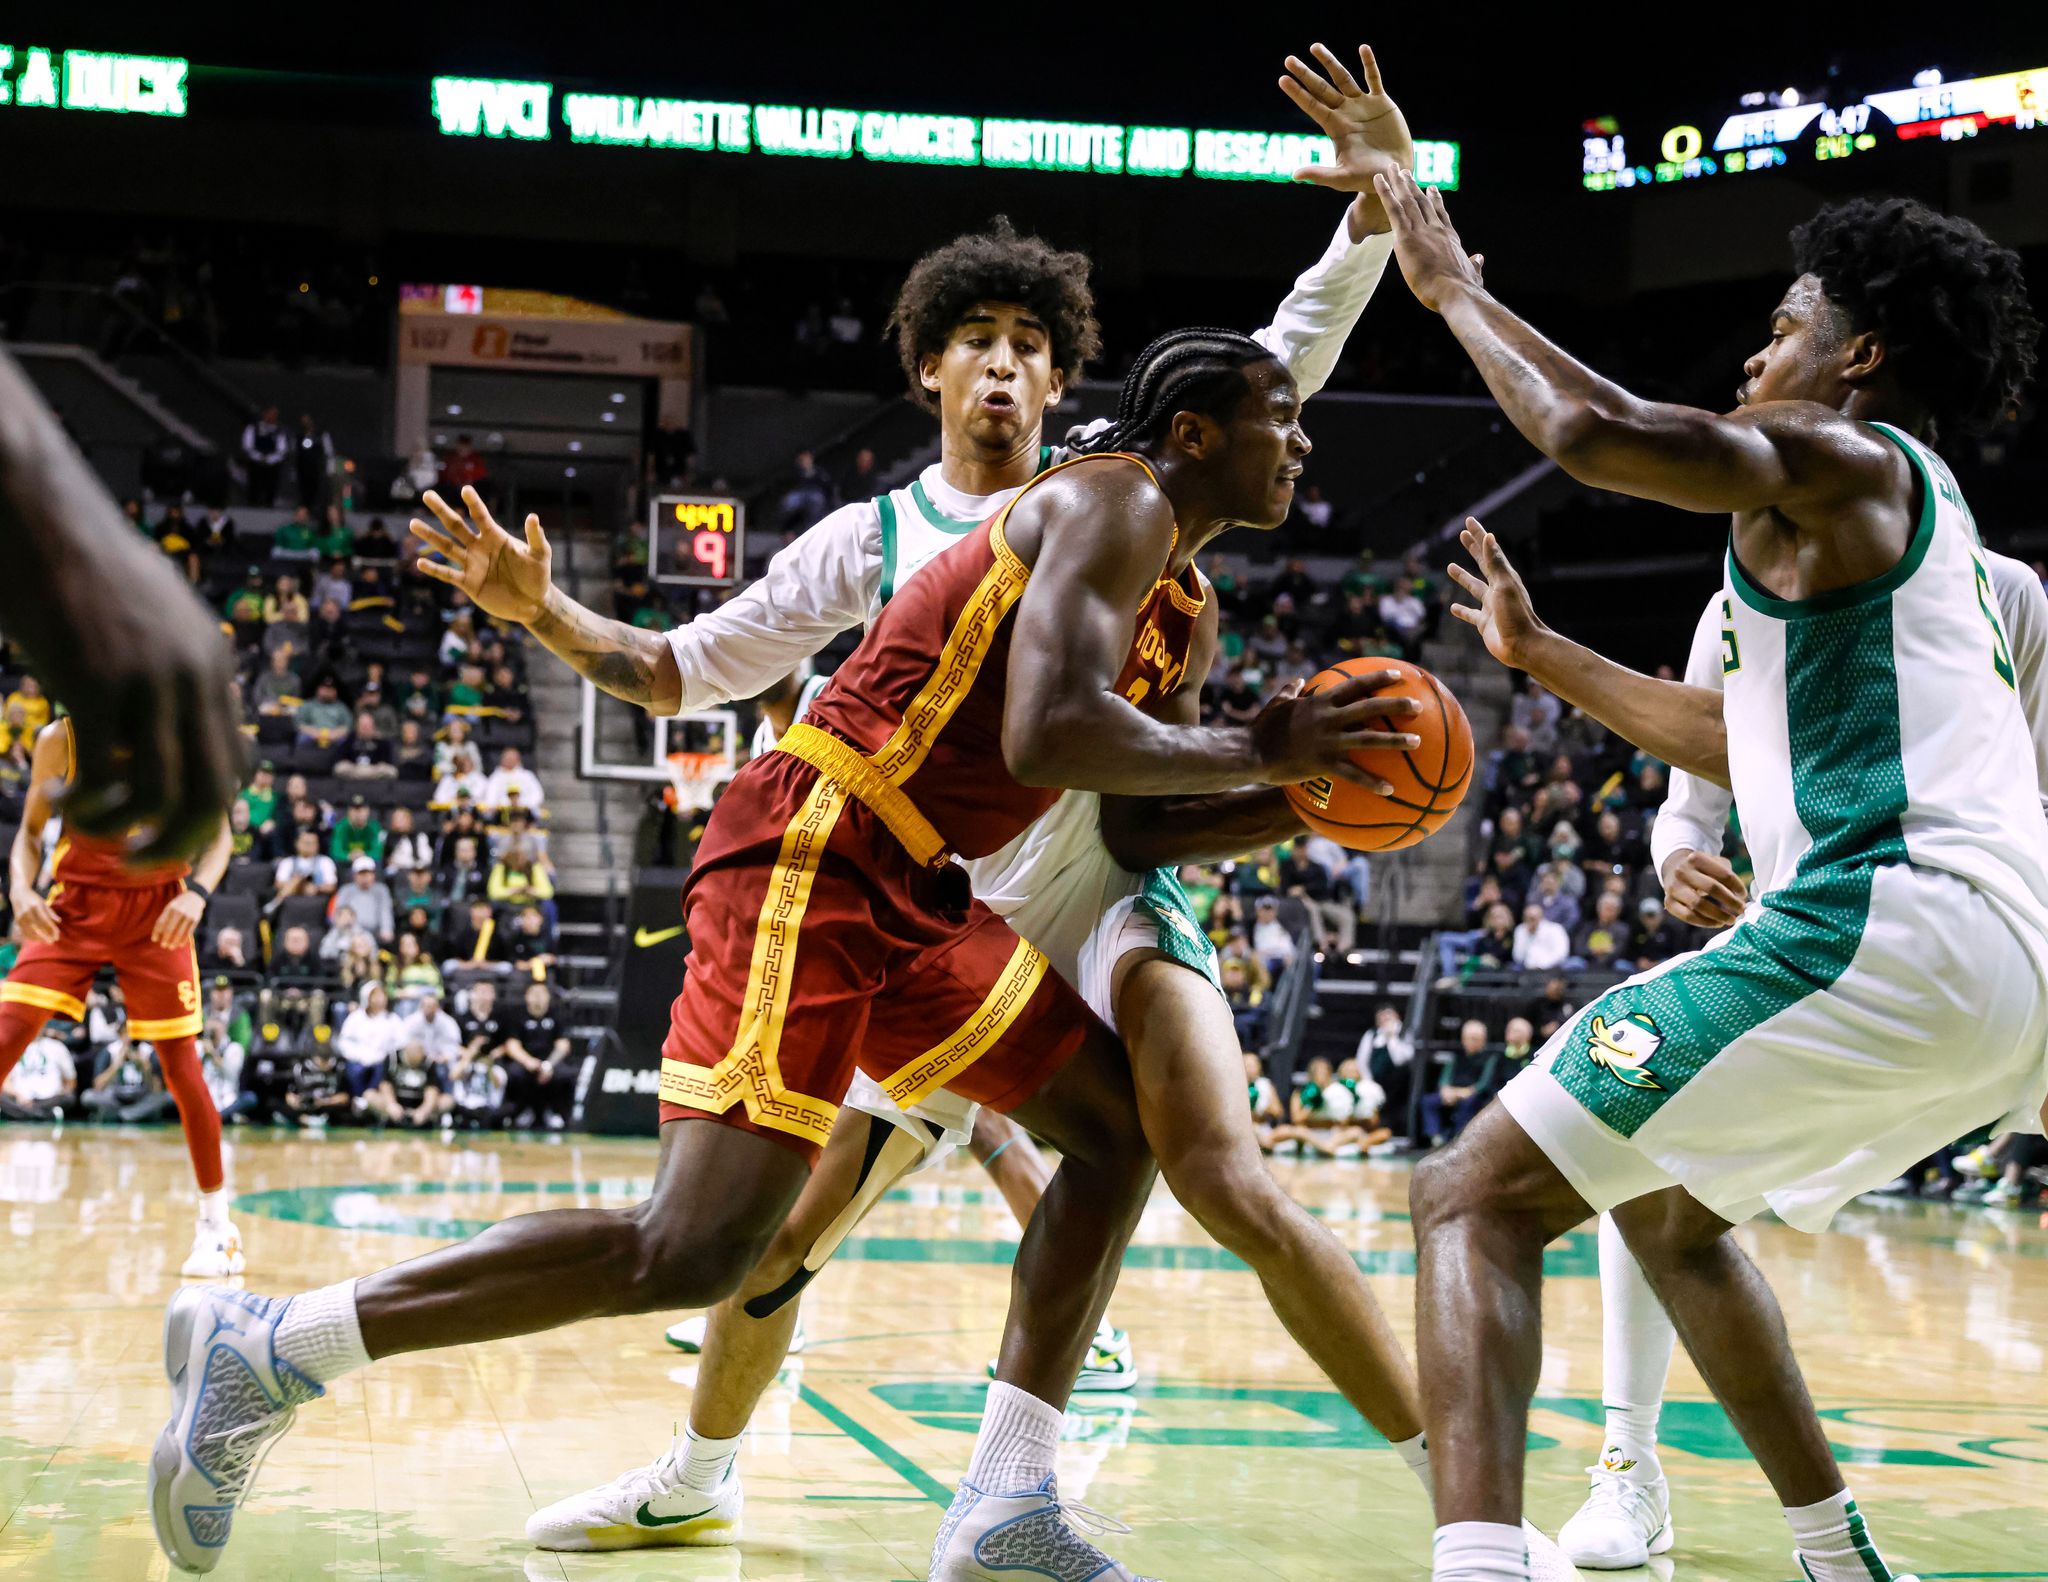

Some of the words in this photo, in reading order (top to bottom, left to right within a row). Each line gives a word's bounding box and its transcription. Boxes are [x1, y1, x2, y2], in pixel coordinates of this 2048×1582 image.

[16, 46, 60, 108] A
[62, 49, 188, 117] DUCK
[562, 93, 751, 153] WILLAMETTE
[753, 104, 857, 159] VALLEY
[857, 111, 981, 166] CANCER
[982, 117, 1125, 174] INSTITUTE
[1126, 126, 1192, 177] AND
[693, 531, 726, 579] 9
